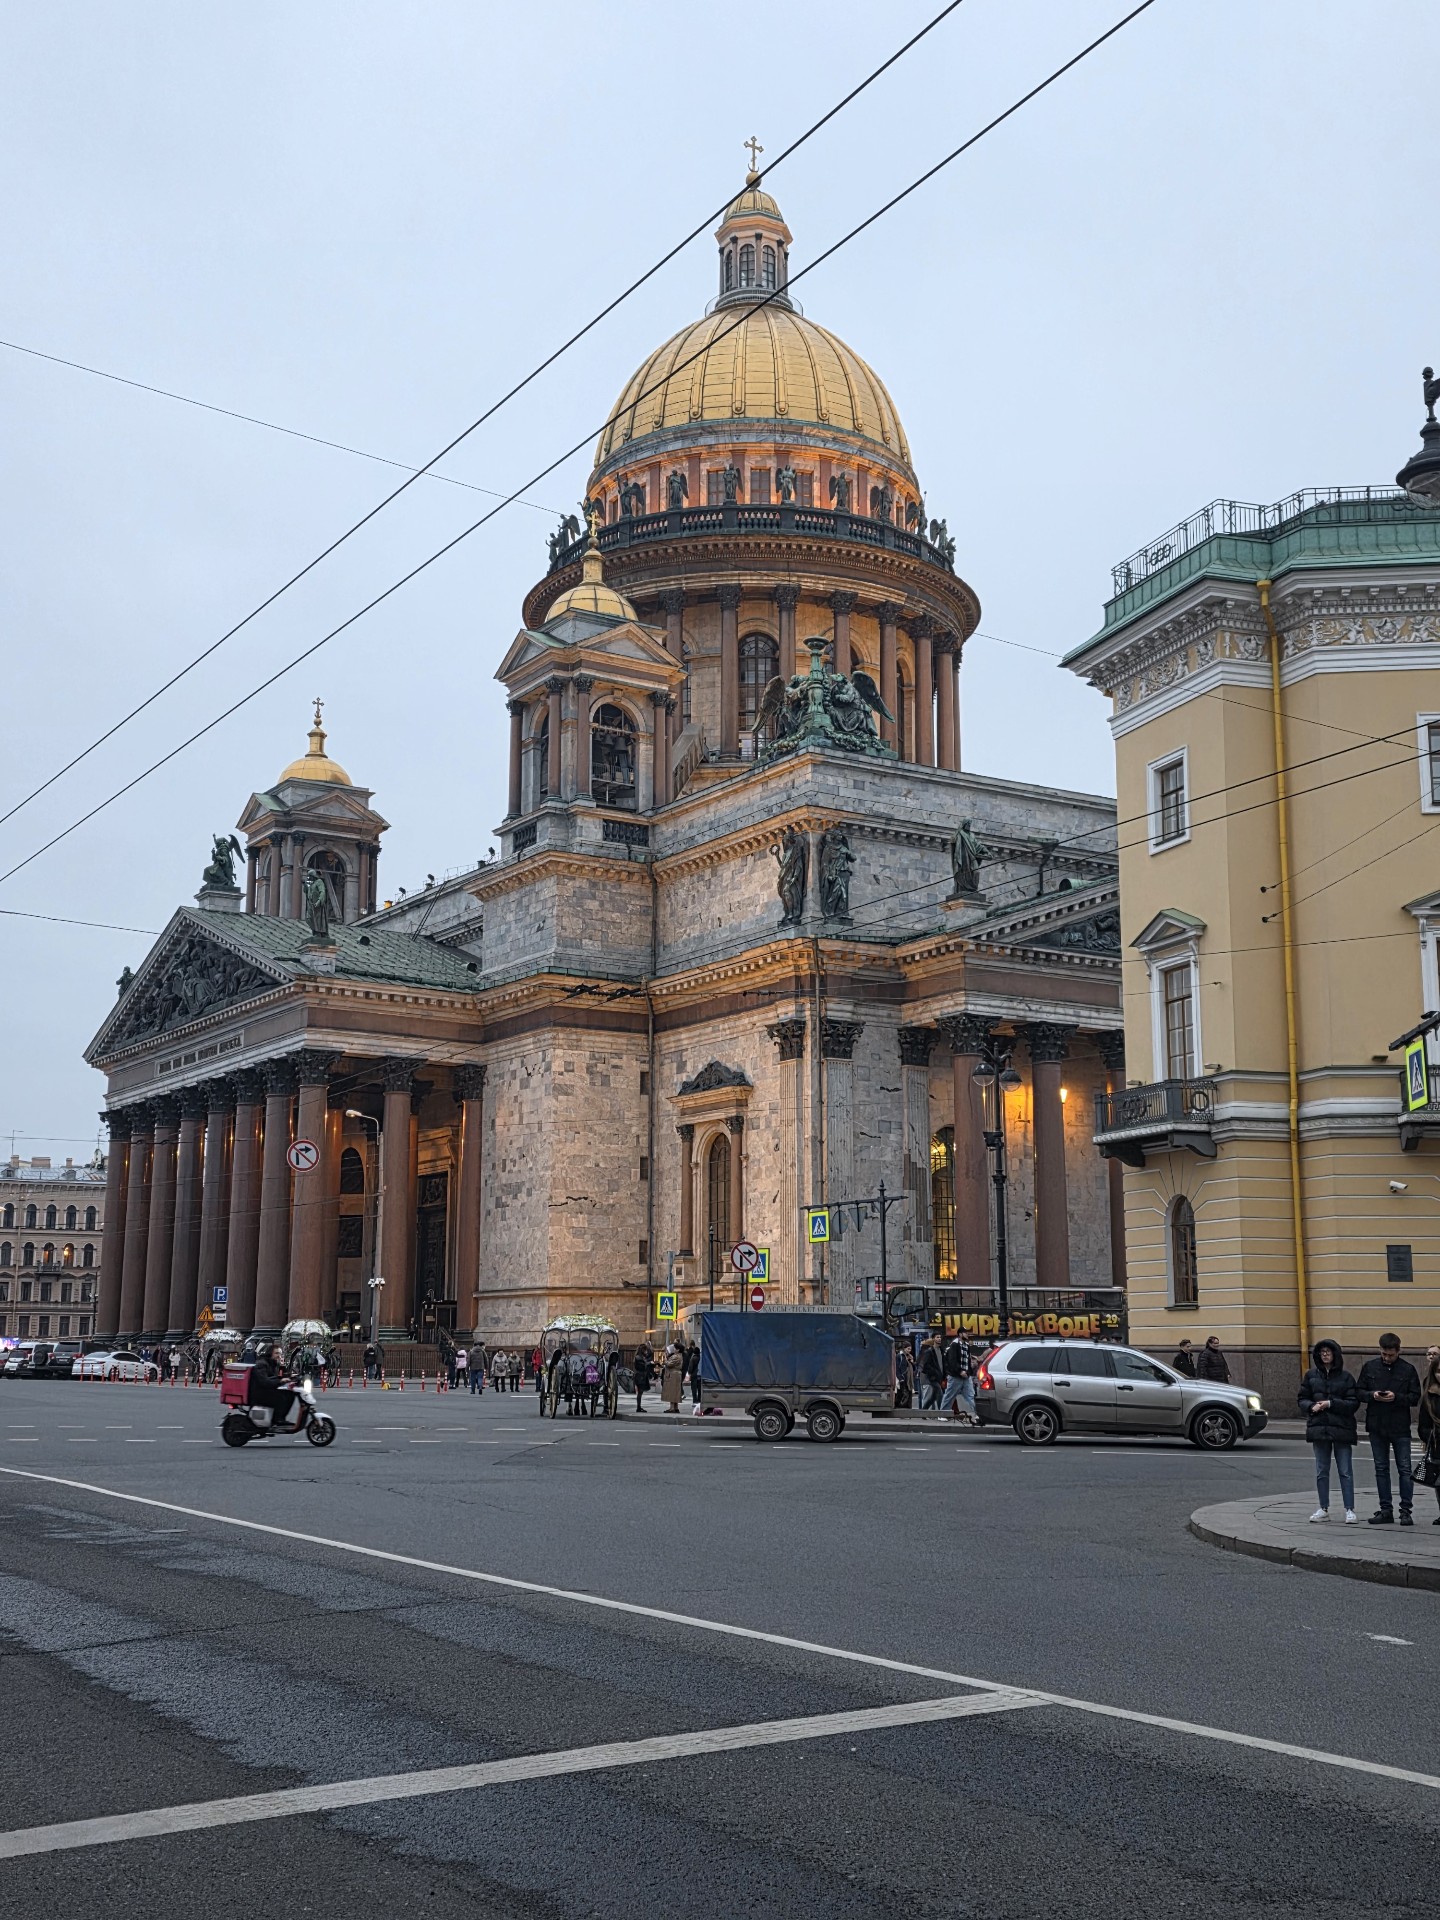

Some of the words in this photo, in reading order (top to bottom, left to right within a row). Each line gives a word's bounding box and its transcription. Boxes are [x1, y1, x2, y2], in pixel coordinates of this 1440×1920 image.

[1015, 1320, 1037, 1335] НА
[1042, 1313, 1100, 1337] ВОДЕ
[1105, 1313, 1118, 1324] 29
